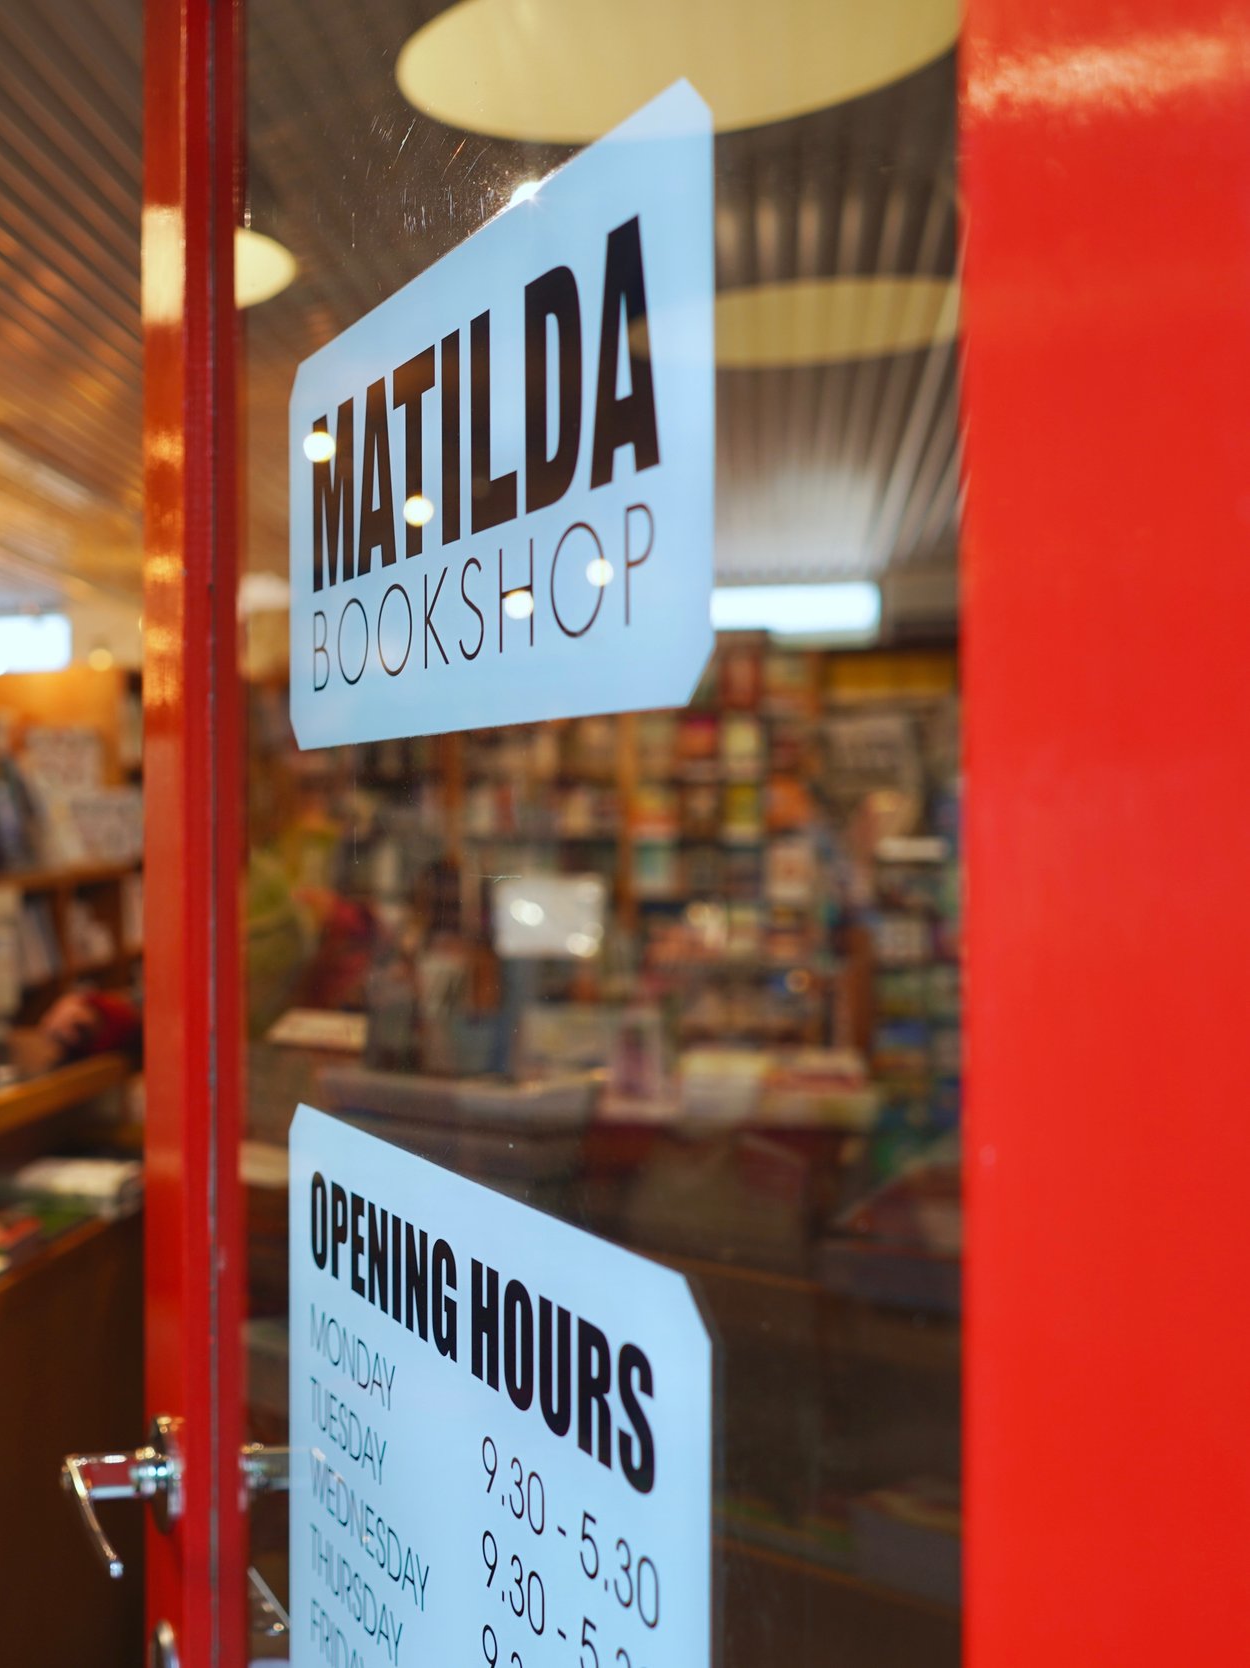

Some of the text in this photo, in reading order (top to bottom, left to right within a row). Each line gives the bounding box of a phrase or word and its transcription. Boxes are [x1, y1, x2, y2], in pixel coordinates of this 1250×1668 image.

[312, 214, 660, 593] MATILDA
[313, 503, 654, 692] BOOKSHOP
[311, 1171, 655, 1494] OPENING HOURS
[310, 1303, 395, 1412] MONDAY
[482, 1436, 545, 1536] 9.30
[580, 1510, 659, 1629] 5.30
[310, 1376, 387, 1486] TUESDAY
[482, 1530, 545, 1636] 9.30
[310, 1448, 430, 1612] WEDNESDAY
[310, 1522, 403, 1667] THURSDAY
[311, 1597, 366, 1668] FRID
